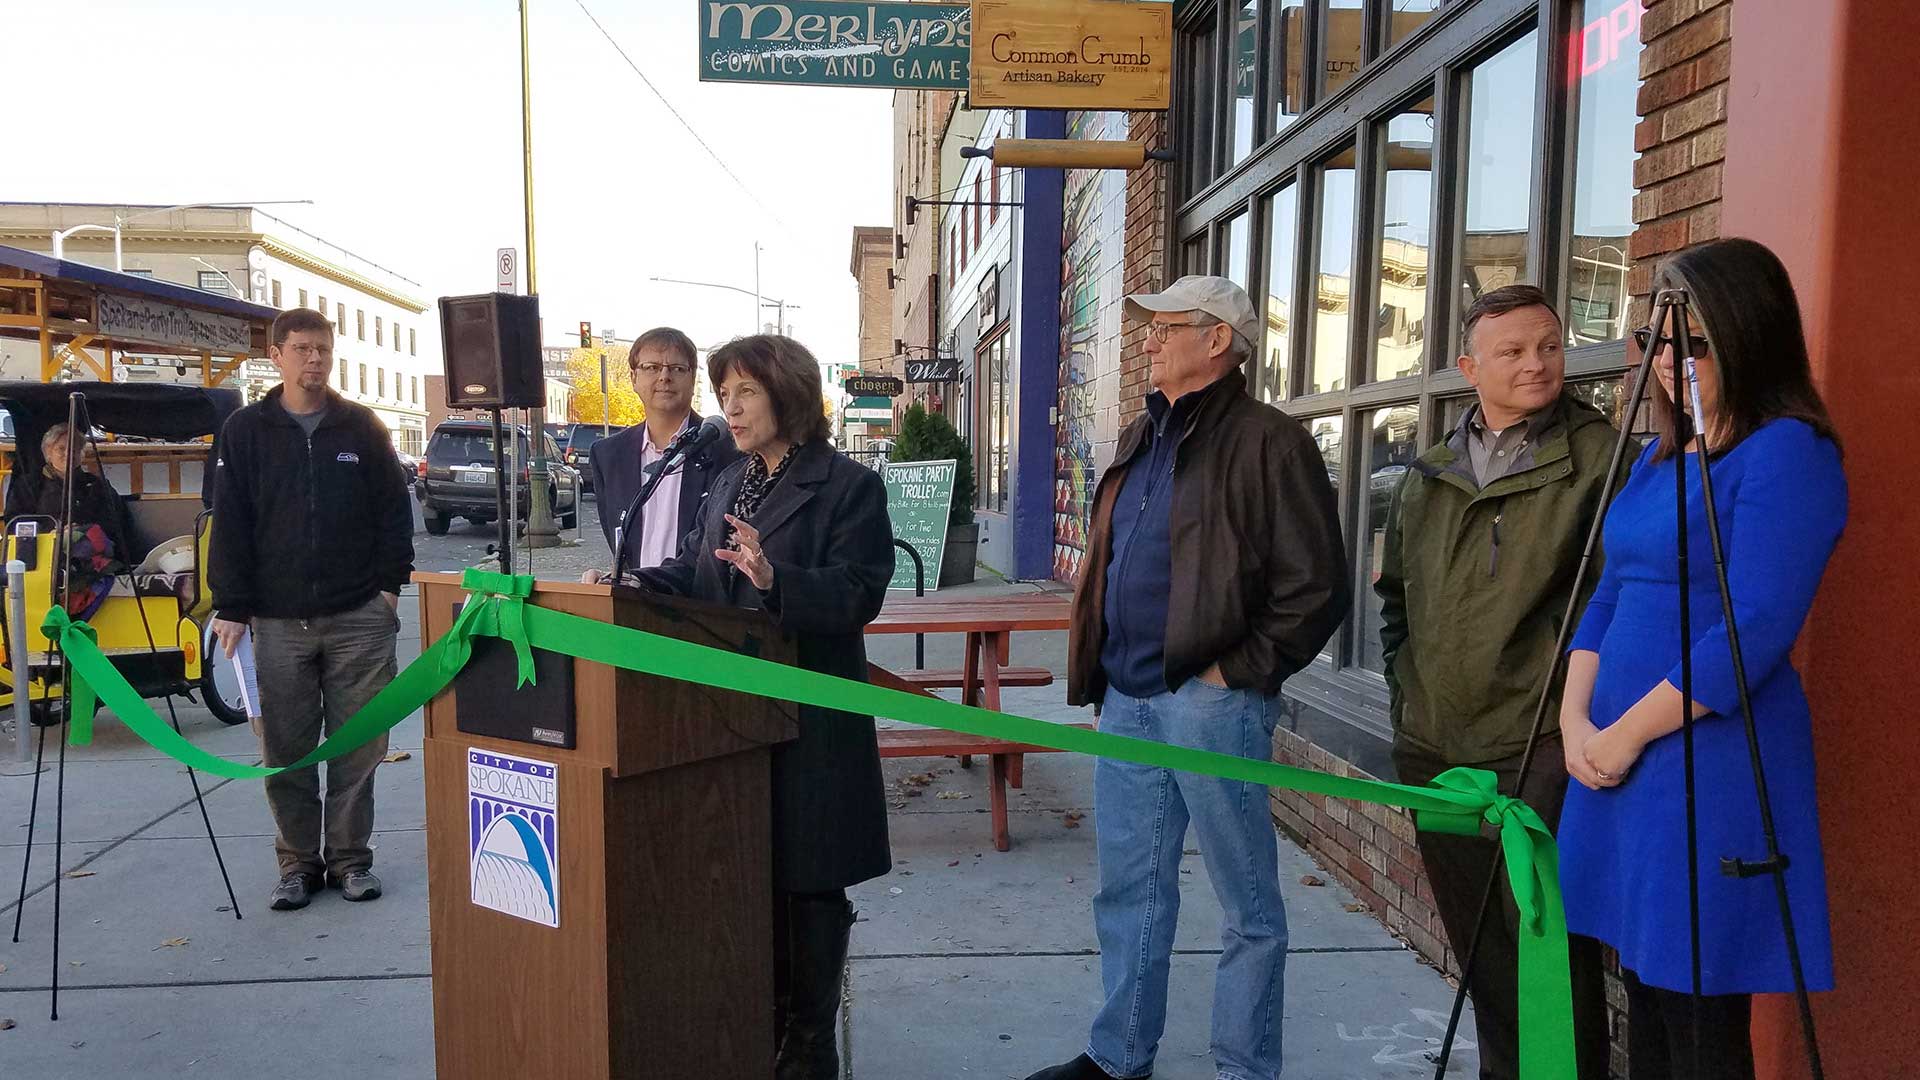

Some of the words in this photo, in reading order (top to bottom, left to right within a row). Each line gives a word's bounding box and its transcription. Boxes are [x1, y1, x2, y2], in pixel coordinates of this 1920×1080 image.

[991, 32, 1078, 65] Common
[1081, 36, 1151, 66] Crumb
[710, 51, 808, 76] COMICS
[825, 58, 876, 77] AND
[893, 58, 970, 81] GAME
[1003, 71, 1052, 83] Artisan
[1057, 71, 1106, 86] Bakery
[888, 467, 924, 483] SPOKANE
[926, 465, 952, 482] PARTY
[471, 753, 514, 770] CITY
[530, 765, 552, 777] OF
[470, 766, 555, 806] SPOKANE
